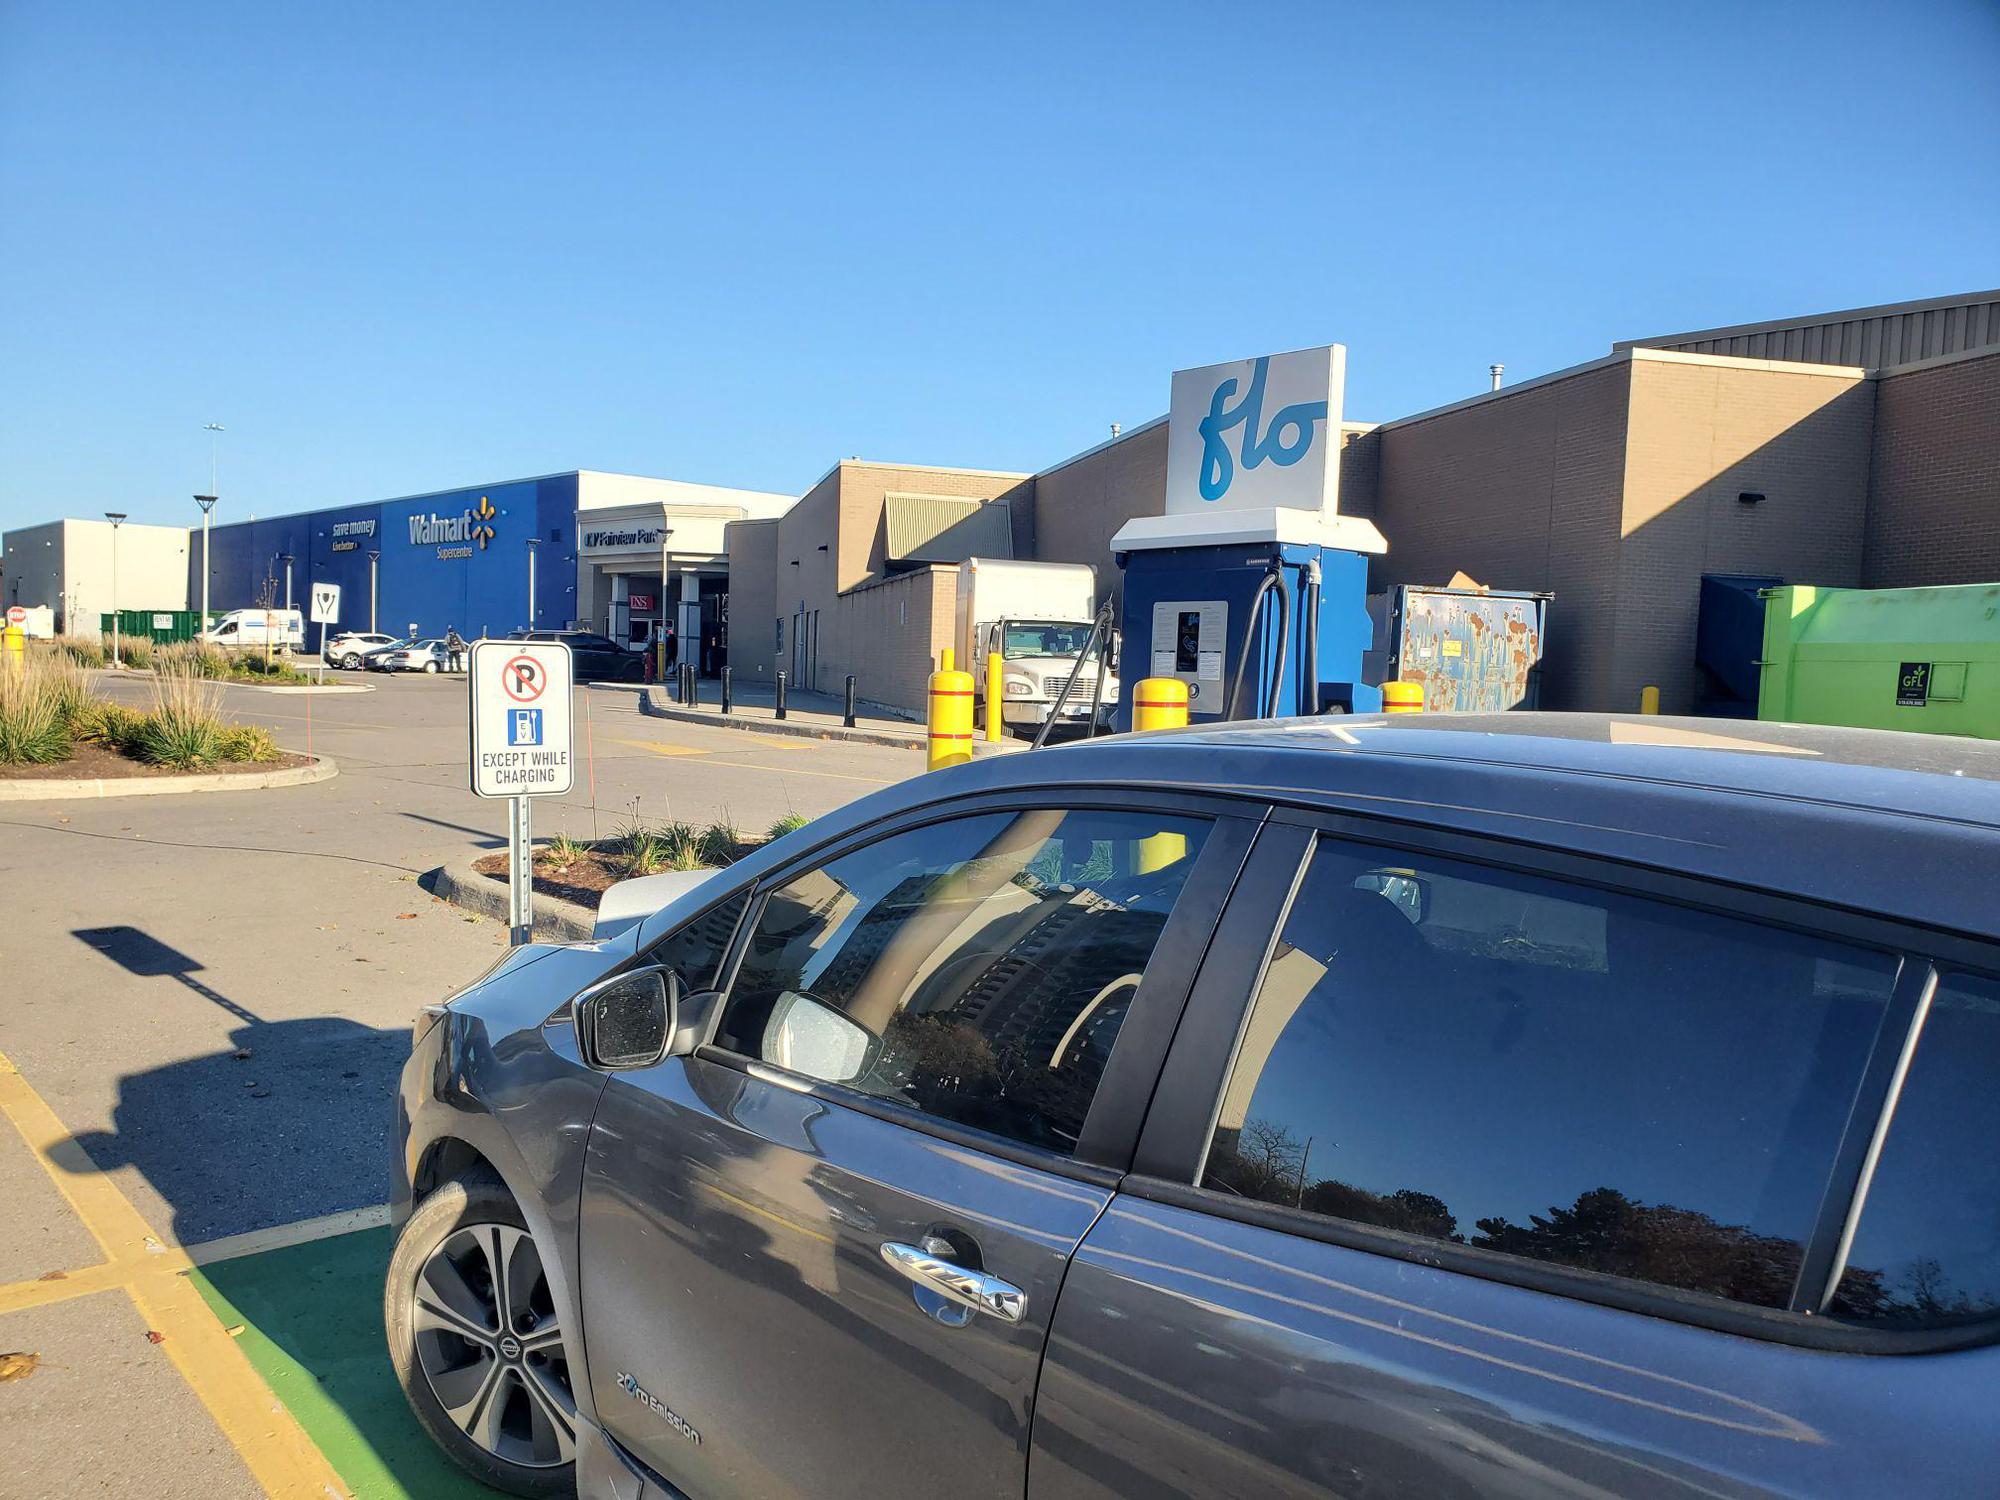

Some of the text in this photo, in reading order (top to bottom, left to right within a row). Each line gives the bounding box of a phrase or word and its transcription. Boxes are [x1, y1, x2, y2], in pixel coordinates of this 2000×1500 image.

[1199, 357, 1328, 501] flo
[350, 520, 375, 537] money
[409, 509, 471, 545] Walmart
[600, 530, 636, 547] Fairview
[437, 546, 472, 560] Supercentre
[1903, 675, 1923, 687] GFL
[483, 751, 567, 767] EXCEPT WHILE
[495, 768, 555, 784] CHARGING
